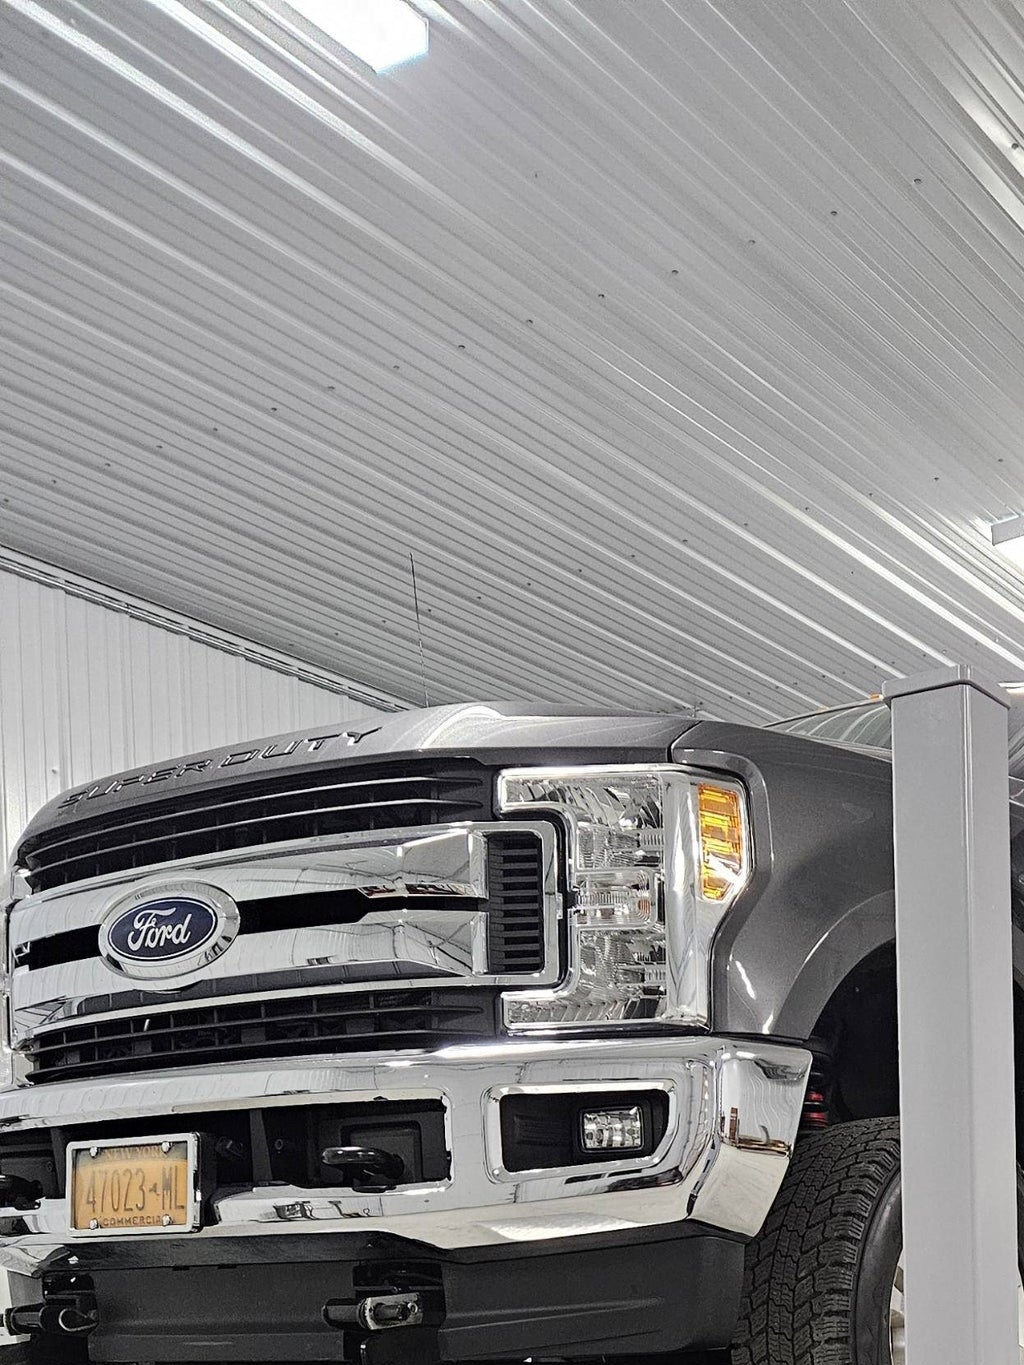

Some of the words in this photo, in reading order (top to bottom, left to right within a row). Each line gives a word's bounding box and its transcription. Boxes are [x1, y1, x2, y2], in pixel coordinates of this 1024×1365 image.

[57, 758, 213, 809] SUPER
[217, 726, 382, 768] DUTY
[127, 907, 192, 951] Ford
[86, 1167, 146, 1213] 47023
[103, 1215, 163, 1227] COMMERCIA
